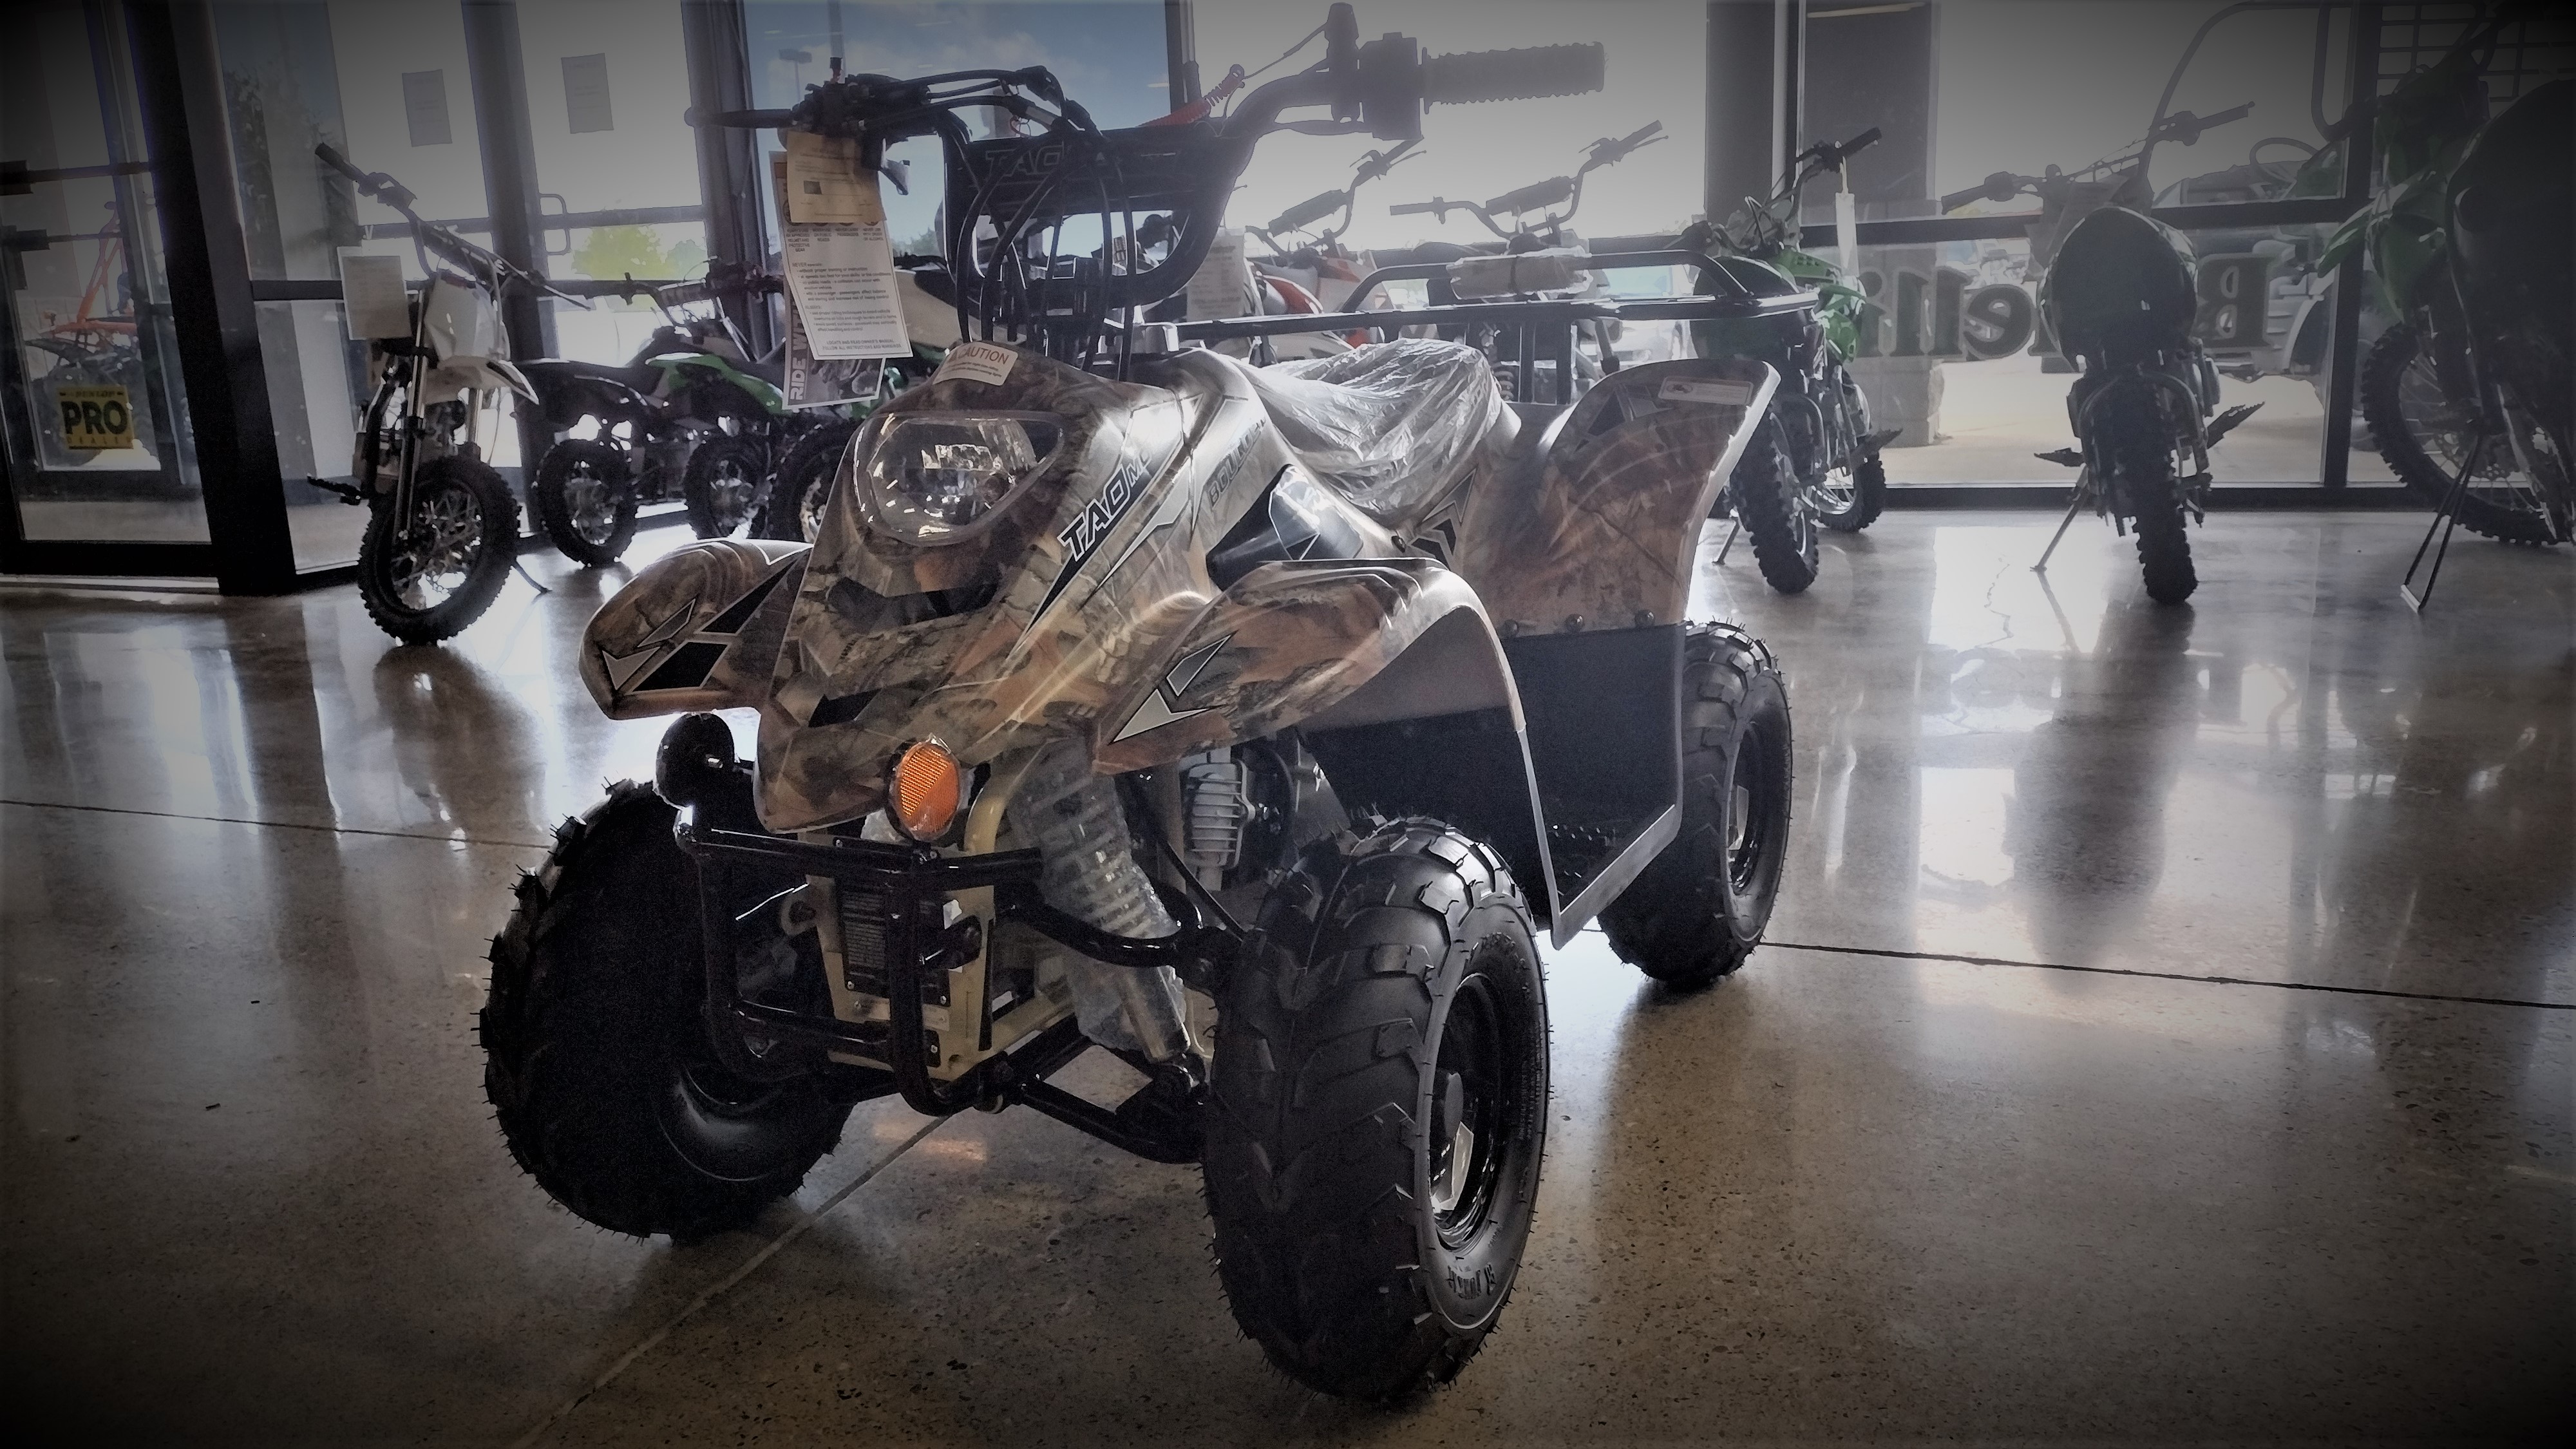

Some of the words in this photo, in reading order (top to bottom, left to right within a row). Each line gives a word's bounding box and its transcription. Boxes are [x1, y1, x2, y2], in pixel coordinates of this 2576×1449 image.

[958, 346, 1010, 365] CAUTION
[790, 357, 806, 401] RIDE
[61, 400, 128, 435] PRO
